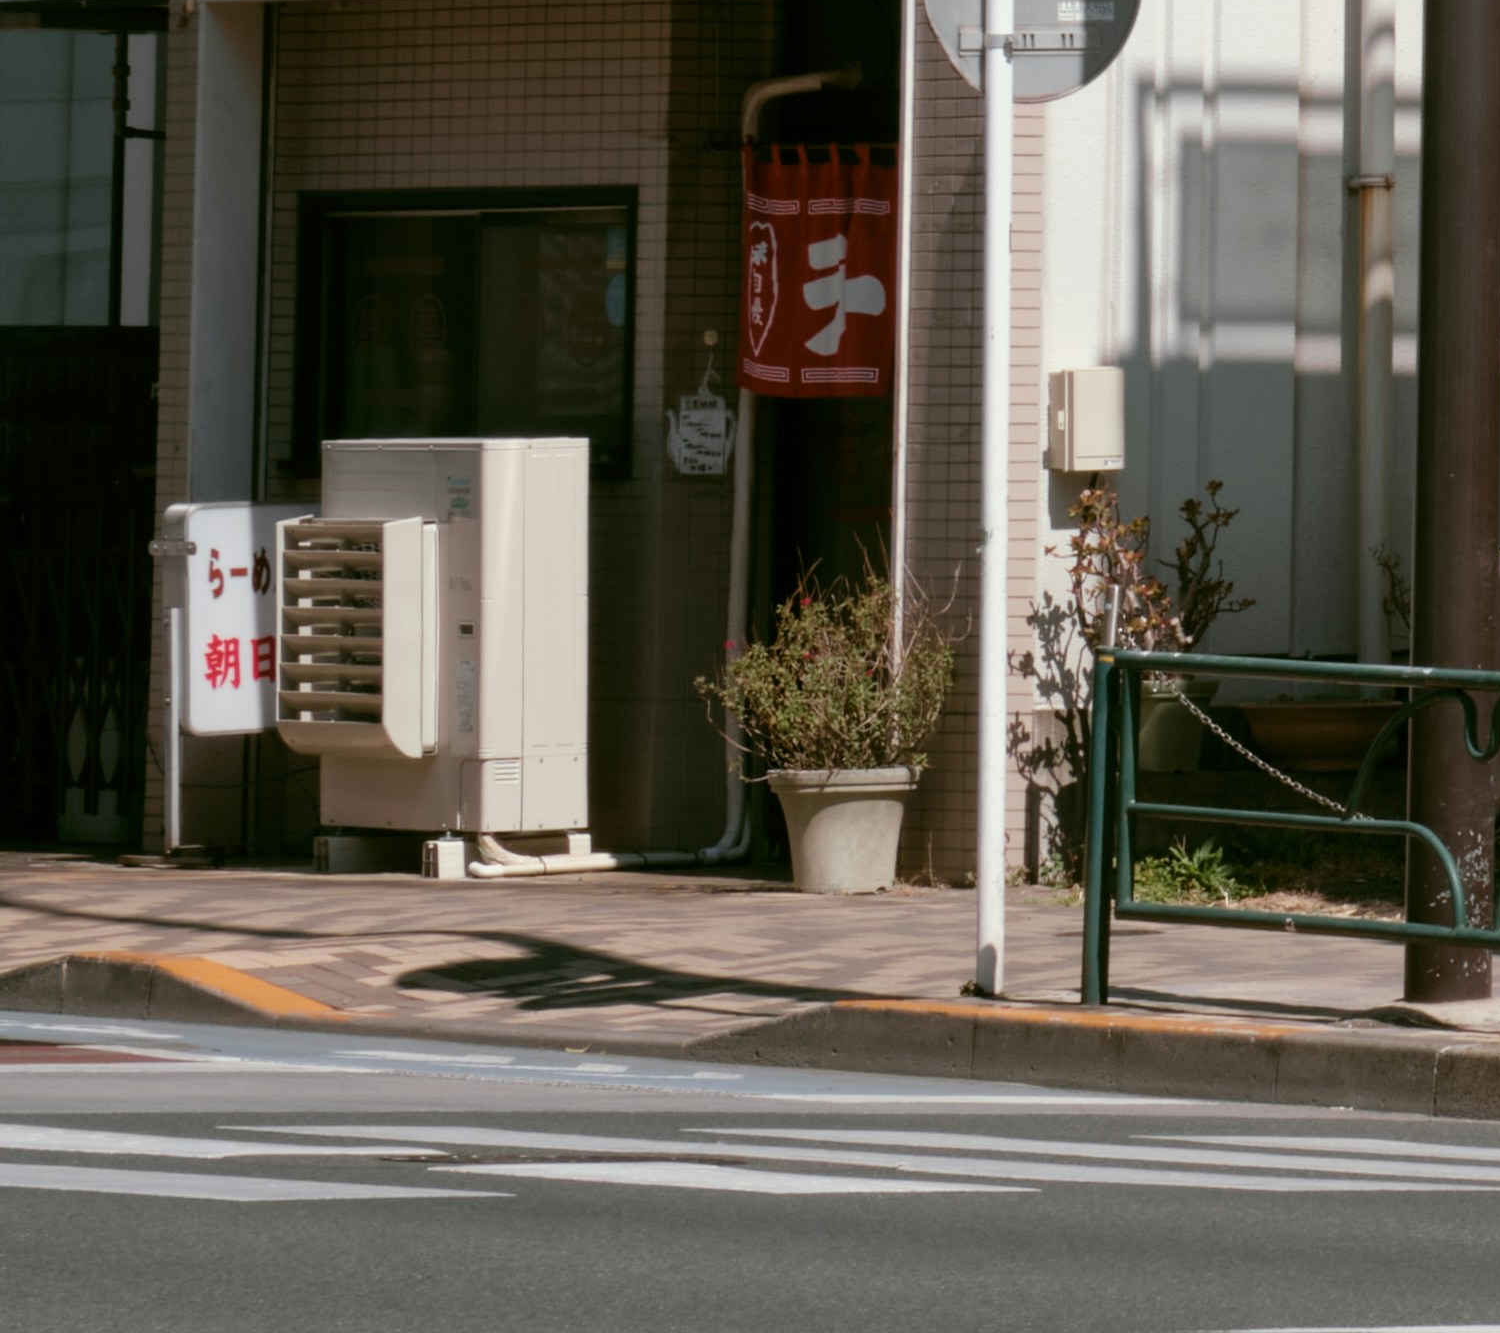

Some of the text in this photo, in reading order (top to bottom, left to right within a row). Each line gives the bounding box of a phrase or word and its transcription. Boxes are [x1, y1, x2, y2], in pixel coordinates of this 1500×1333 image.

[208, 546, 276, 600] らーめ
[204, 634, 277, 690] 朝日
